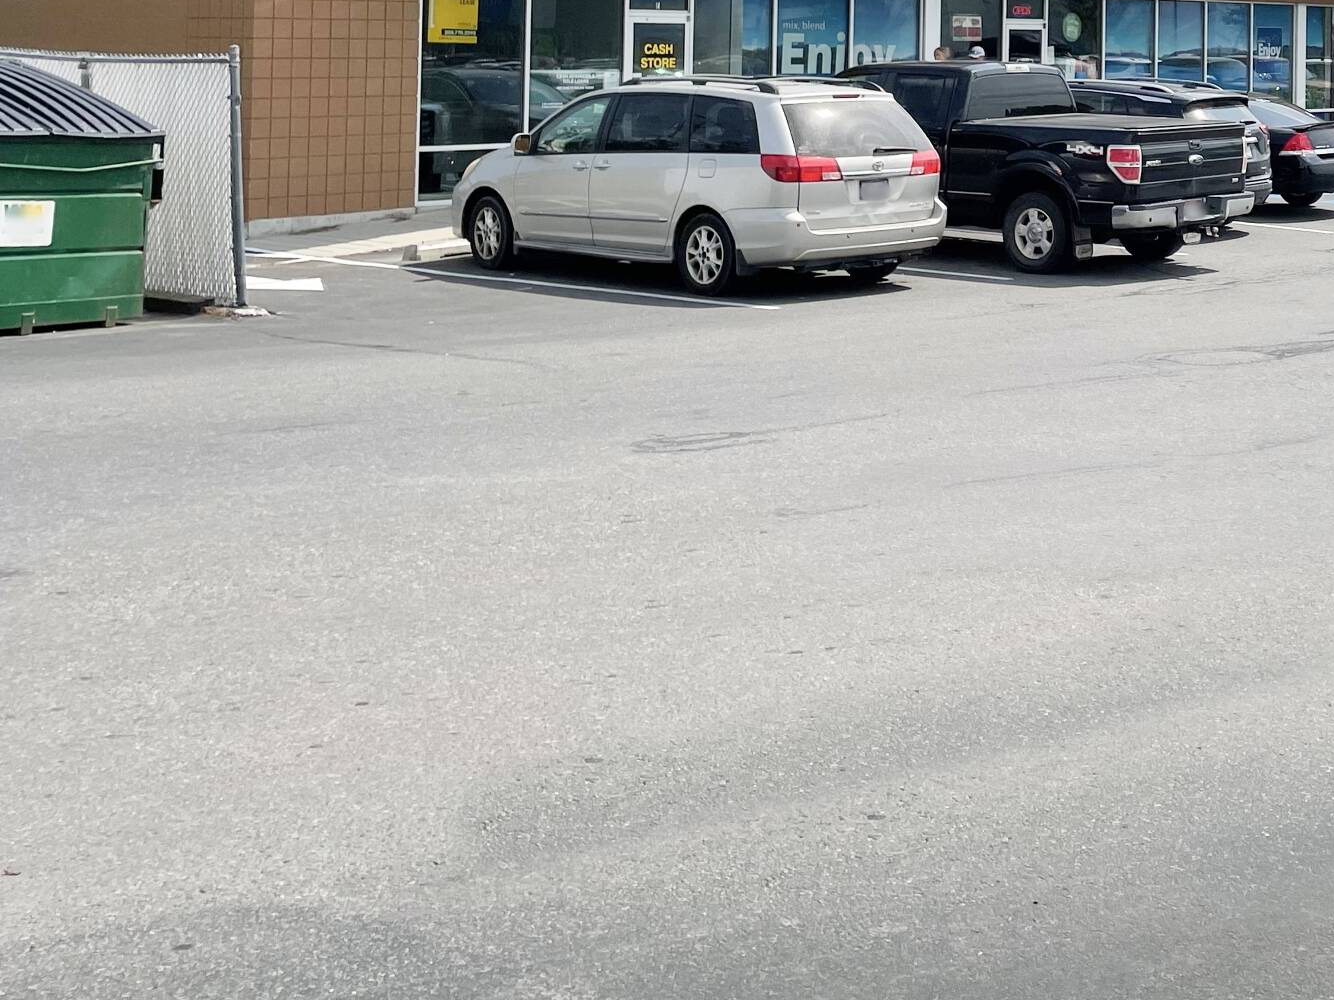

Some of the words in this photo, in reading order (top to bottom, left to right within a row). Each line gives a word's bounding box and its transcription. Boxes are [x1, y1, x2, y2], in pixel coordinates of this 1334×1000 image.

[802, 20, 826, 30] blend
[644, 43, 673, 55] CASH
[1258, 42, 1281, 59] Enjoy
[640, 57, 676, 69] STORE
